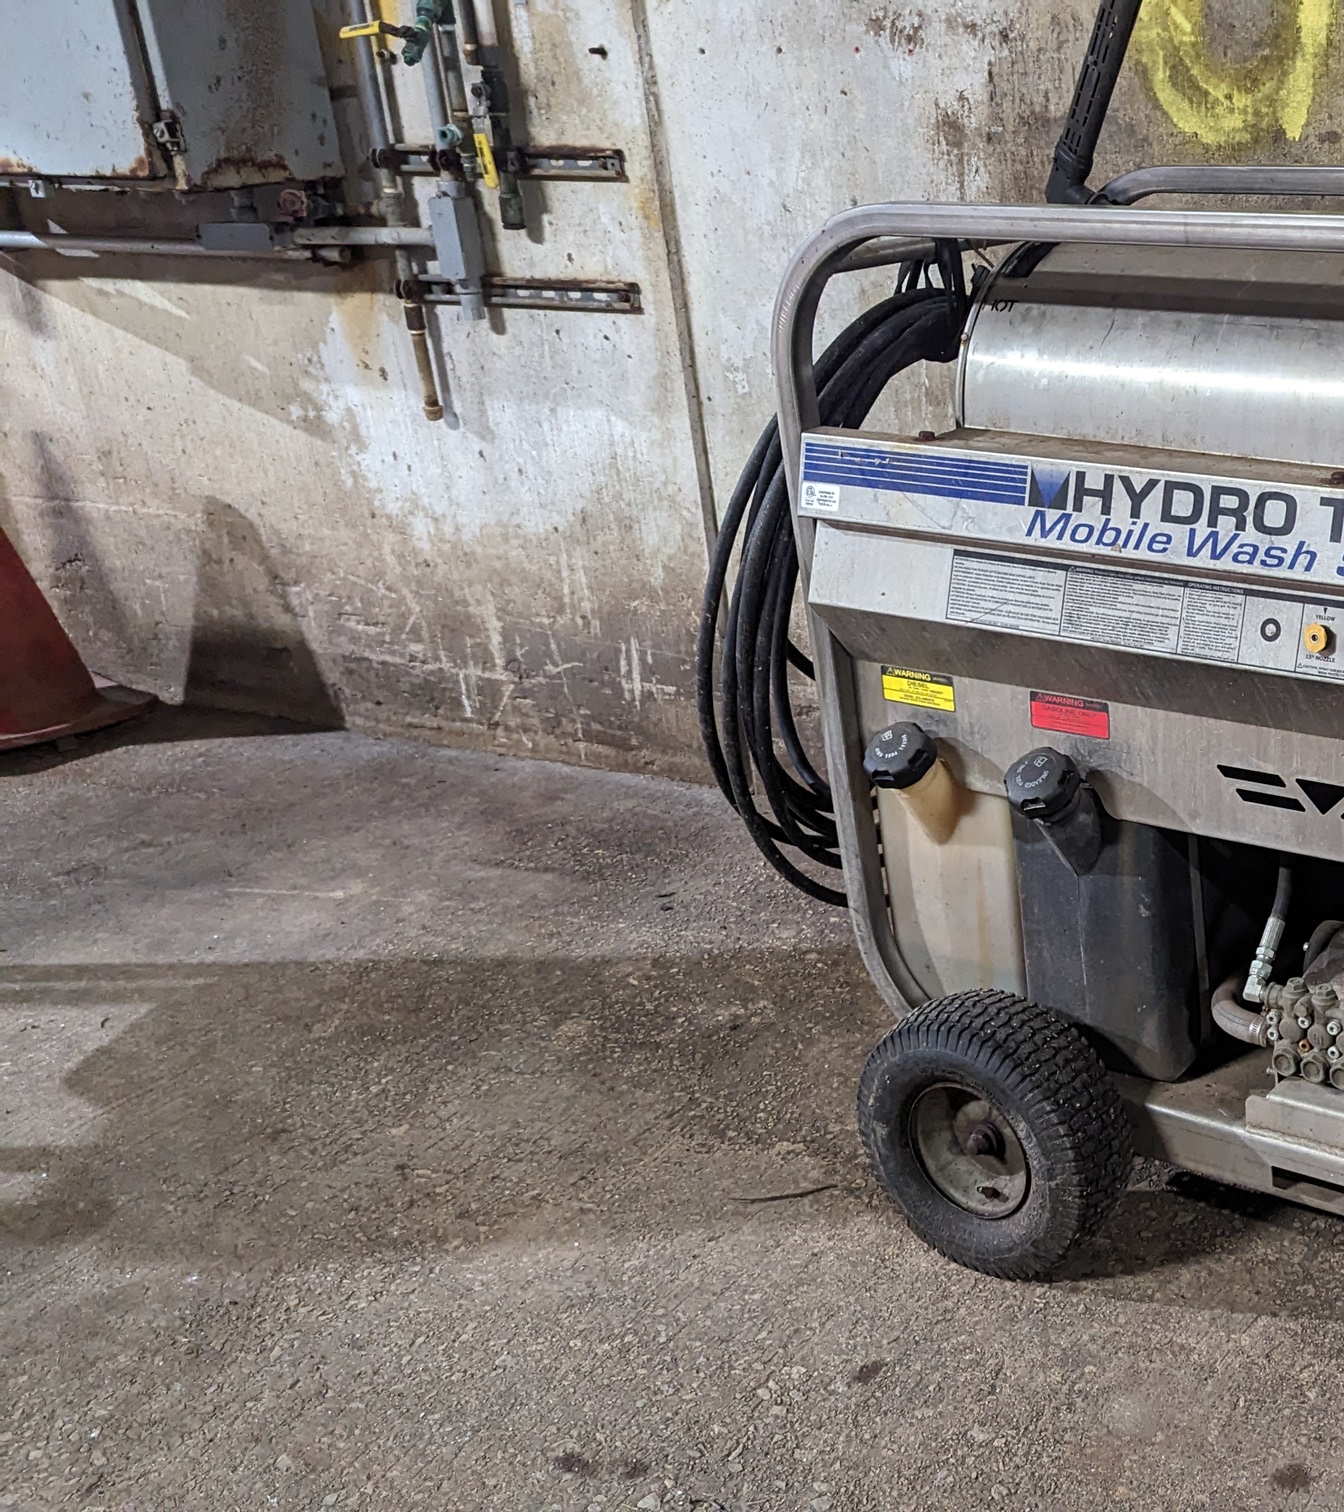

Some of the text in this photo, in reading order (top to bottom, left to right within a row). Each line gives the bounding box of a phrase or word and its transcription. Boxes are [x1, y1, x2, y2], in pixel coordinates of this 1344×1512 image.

[1072, 470, 1297, 536] HYDRO
[1025, 509, 1172, 554] Mobile
[1186, 529, 1318, 573] Wash
[1187, 582, 1244, 594] OPERATING INSTRUCTIONS
[1315, 614, 1336, 622] YELLOW
[1315, 655, 1336, 663] NOZZLE
[893, 668, 931, 681] WARNING
[906, 680, 929, 689] DIESEL
[1043, 694, 1084, 707] WARNING
[1042, 704, 1077, 714] GASOLINE
[1077, 709, 1096, 718] ONLY
[1024, 770, 1049, 788] UNLEADED
